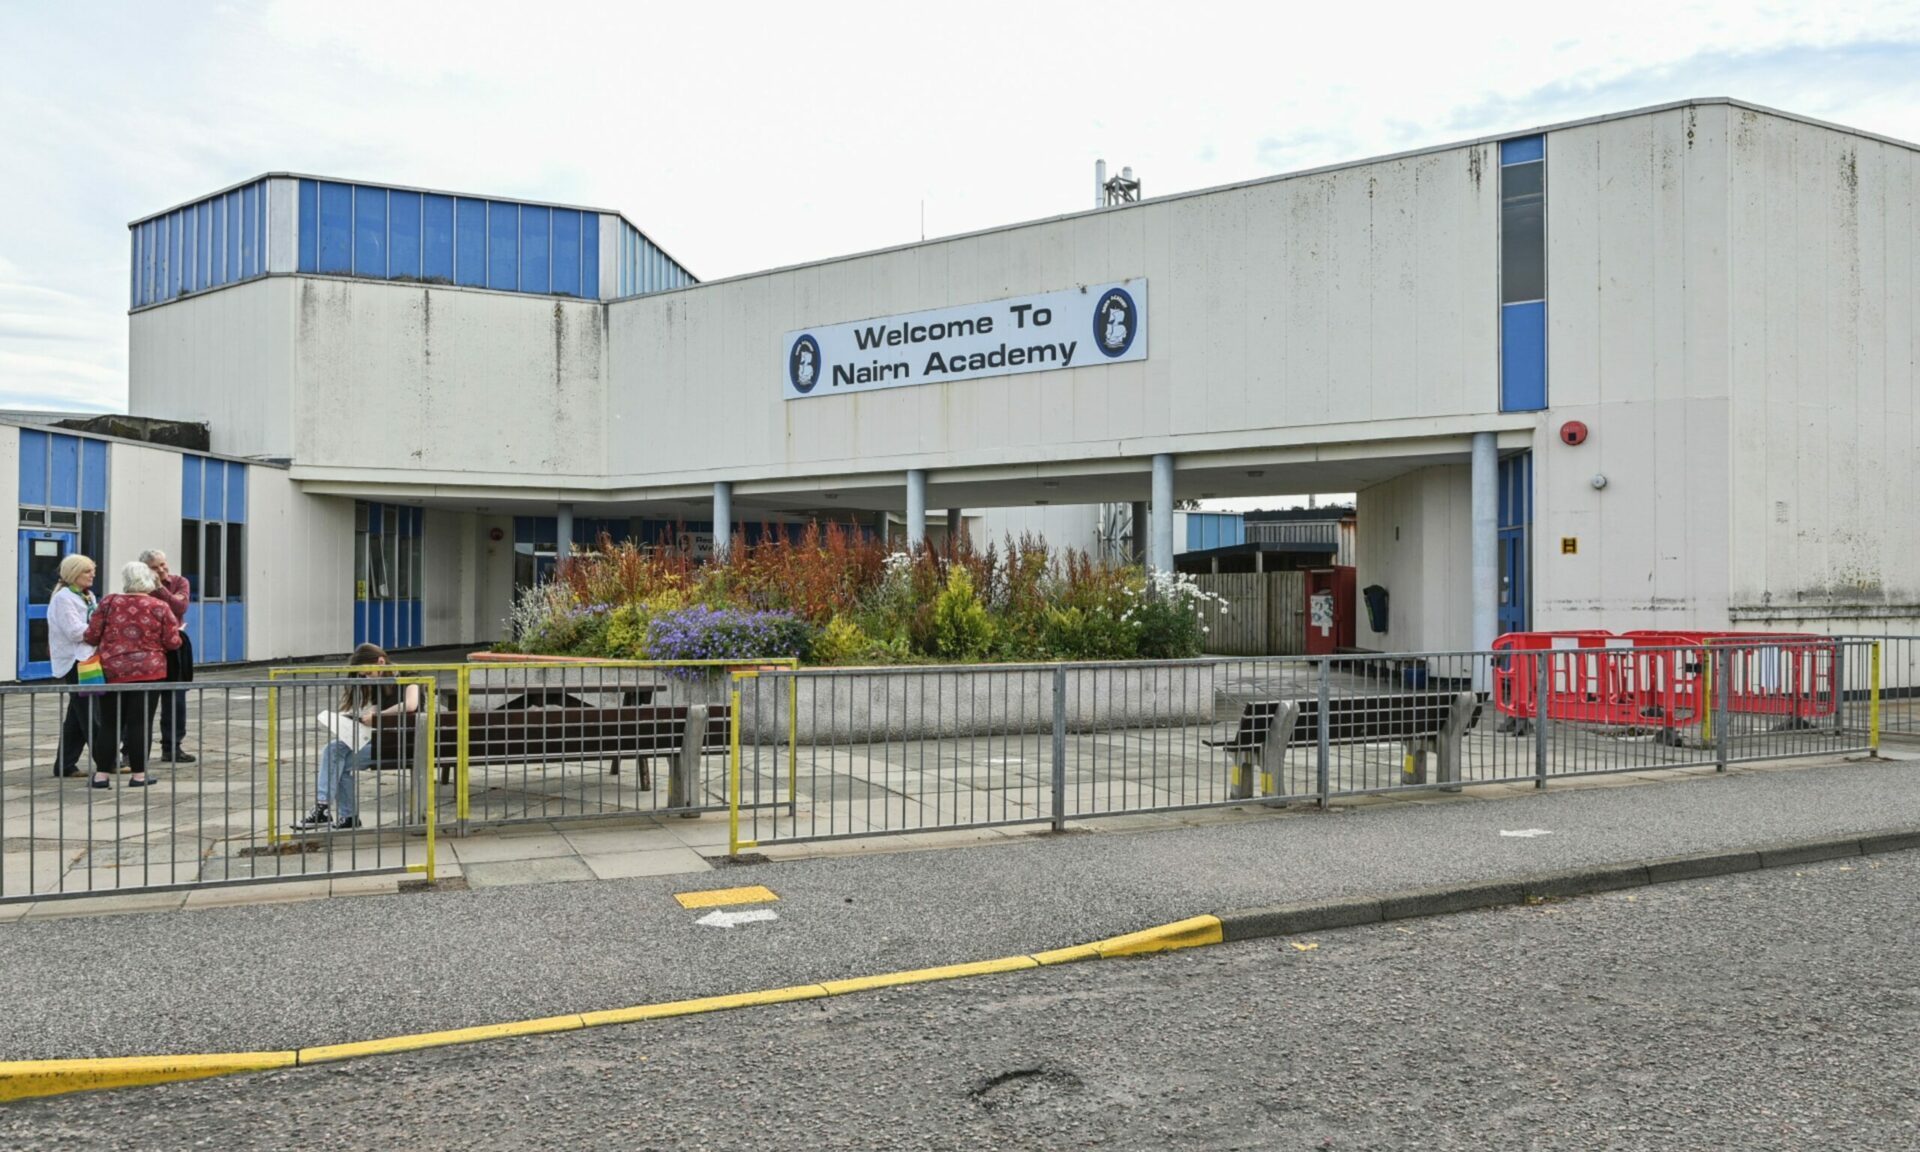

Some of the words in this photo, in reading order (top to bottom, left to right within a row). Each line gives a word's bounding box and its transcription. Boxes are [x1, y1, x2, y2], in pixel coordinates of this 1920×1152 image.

[854, 316, 993, 350] Welcome
[1010, 303, 1052, 329] To
[832, 360, 910, 386] Nairn
[923, 341, 1078, 377] Academy
